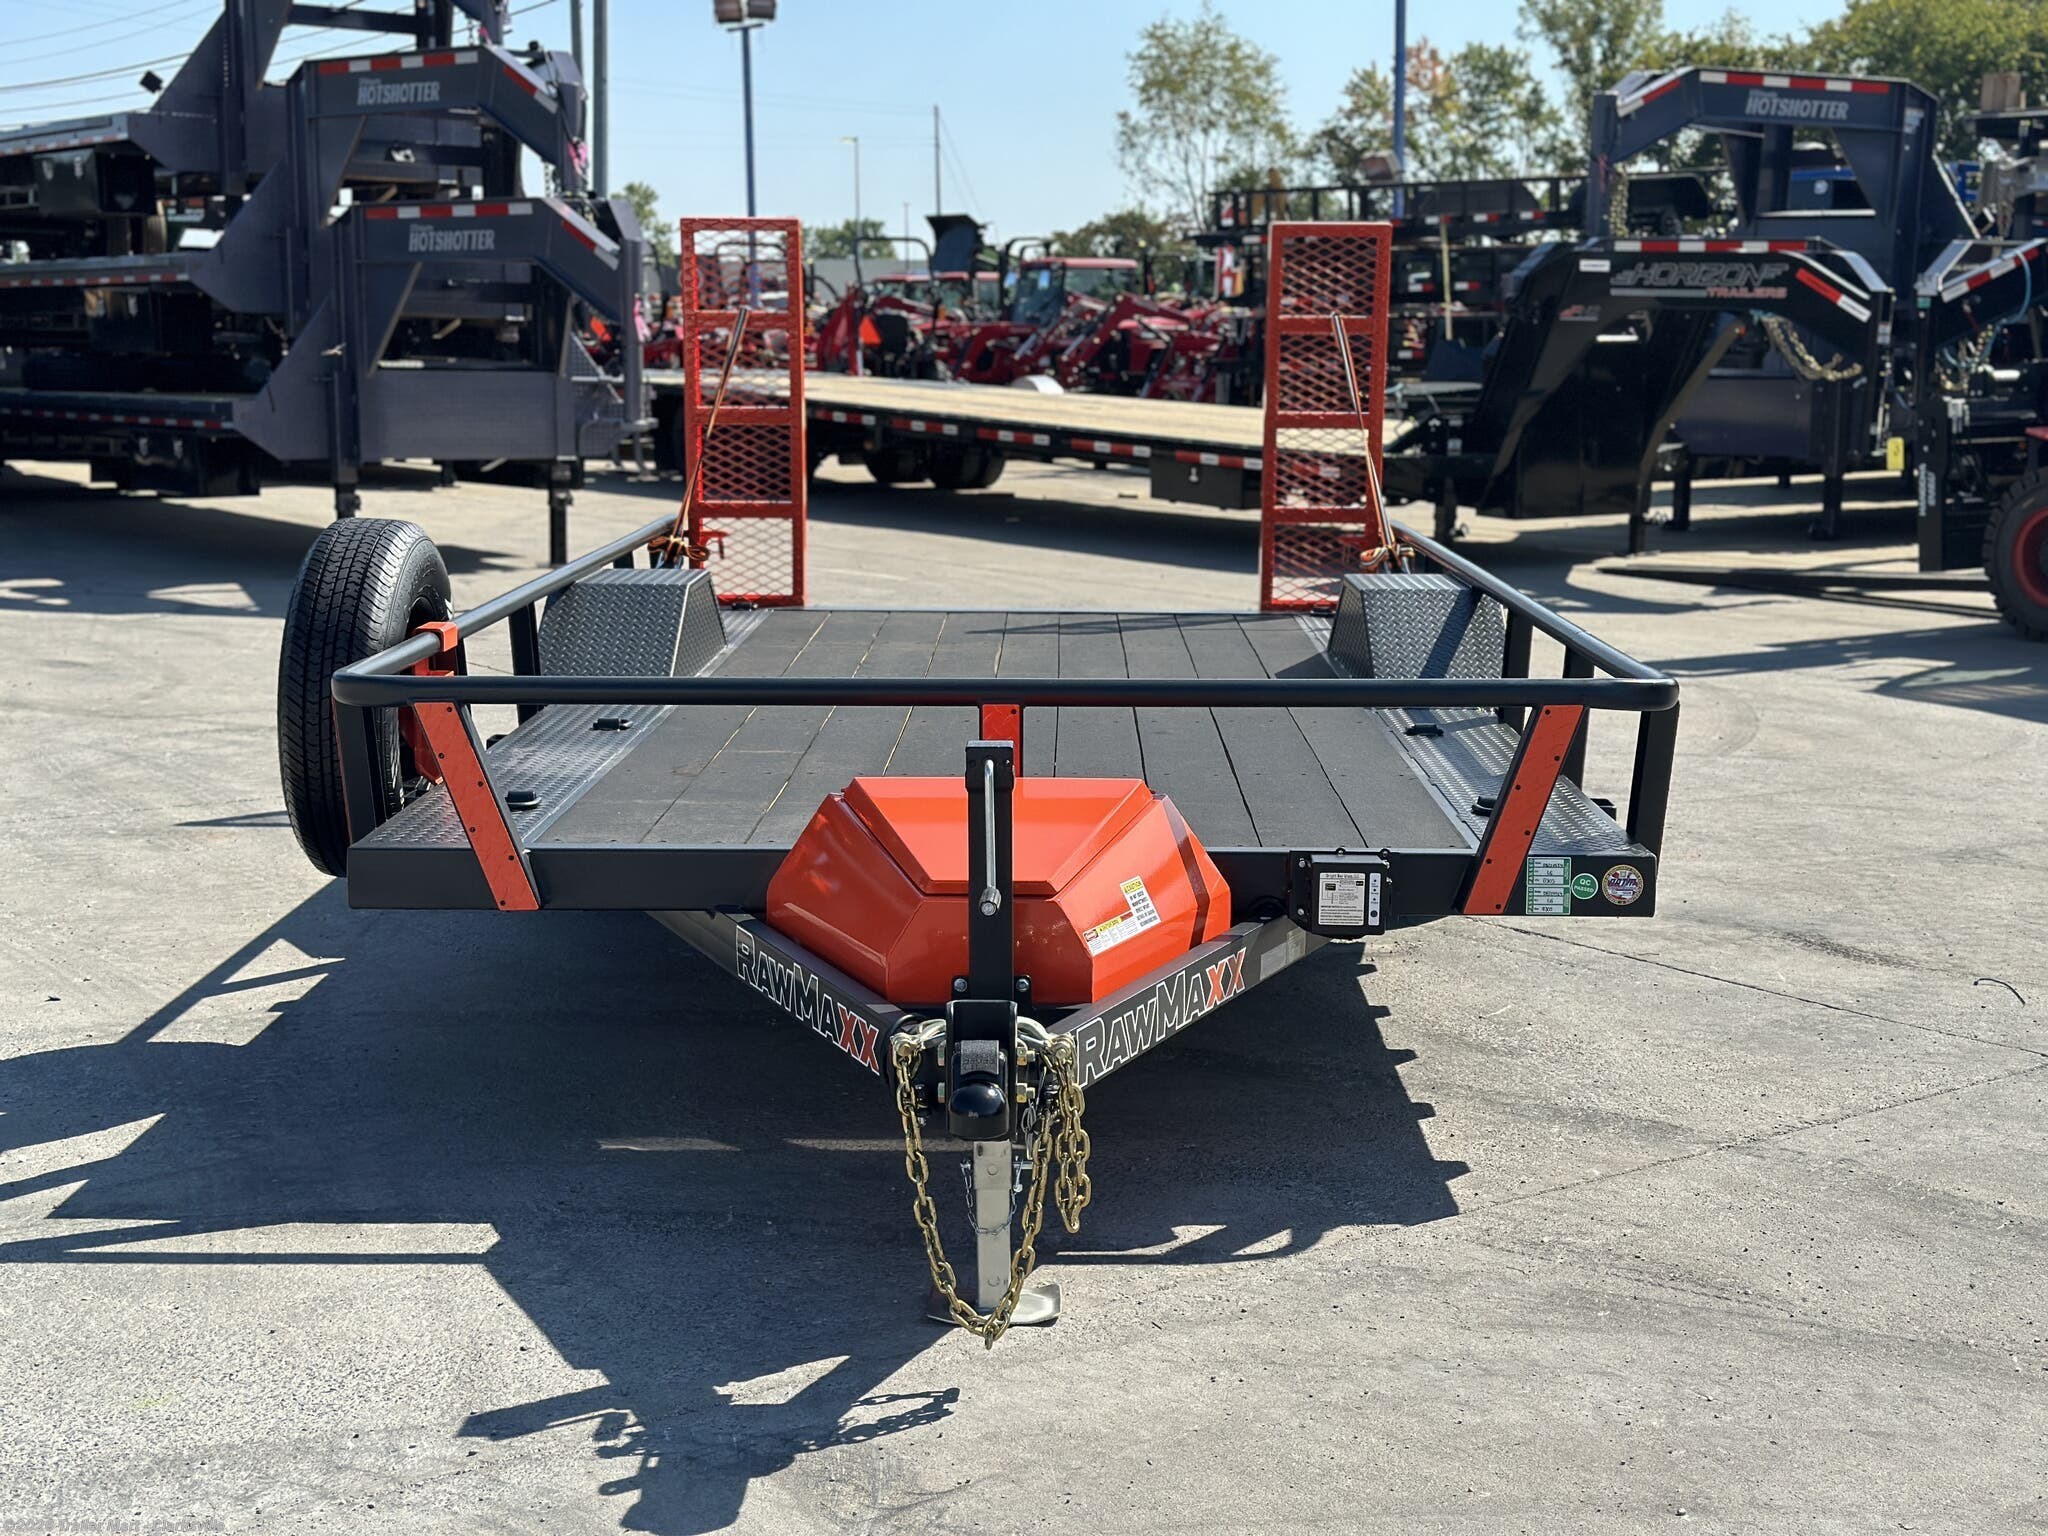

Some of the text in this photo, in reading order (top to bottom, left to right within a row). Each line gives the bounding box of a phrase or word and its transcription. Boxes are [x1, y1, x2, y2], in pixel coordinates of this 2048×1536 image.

[357, 81, 440, 105] HOTSHOTTER
[1745, 96, 1849, 120] HOTSHOTTER
[408, 229, 495, 252] HOTSHOTTER
[1624, 262, 1777, 286] HORIZON
[1706, 286, 1788, 299] TRAILERS
[1573, 885, 1594, 893] PASSED
[1579, 878, 1591, 886] QC
